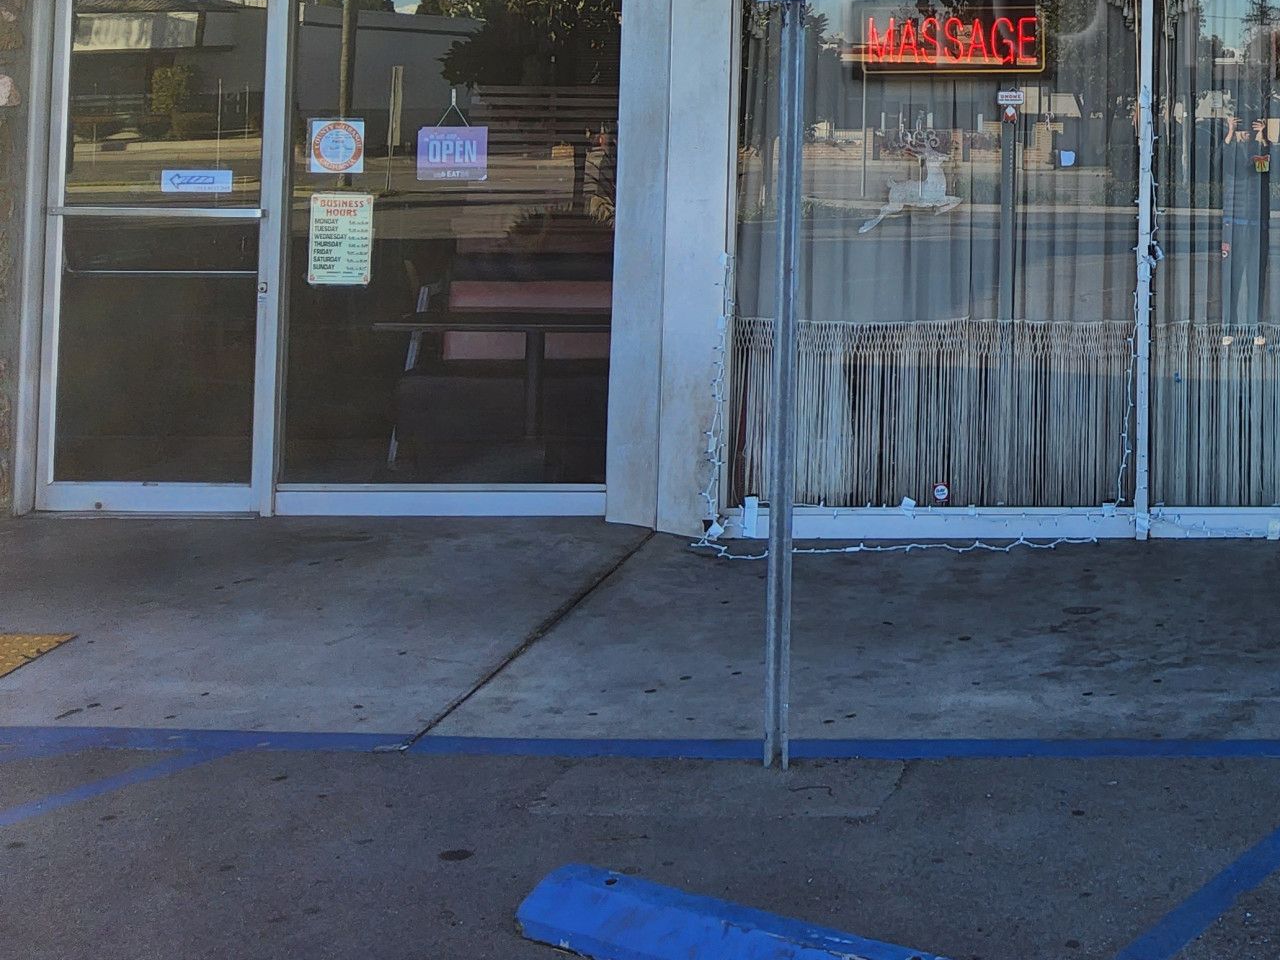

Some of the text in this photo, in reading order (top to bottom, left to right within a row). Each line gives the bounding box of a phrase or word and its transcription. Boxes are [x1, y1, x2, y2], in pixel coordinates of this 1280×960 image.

[866, 15, 1038, 65] MASSAGE
[428, 140, 477, 163] OPEN
[320, 199, 364, 208] BUSINESS
[326, 208, 358, 217] HOURS
